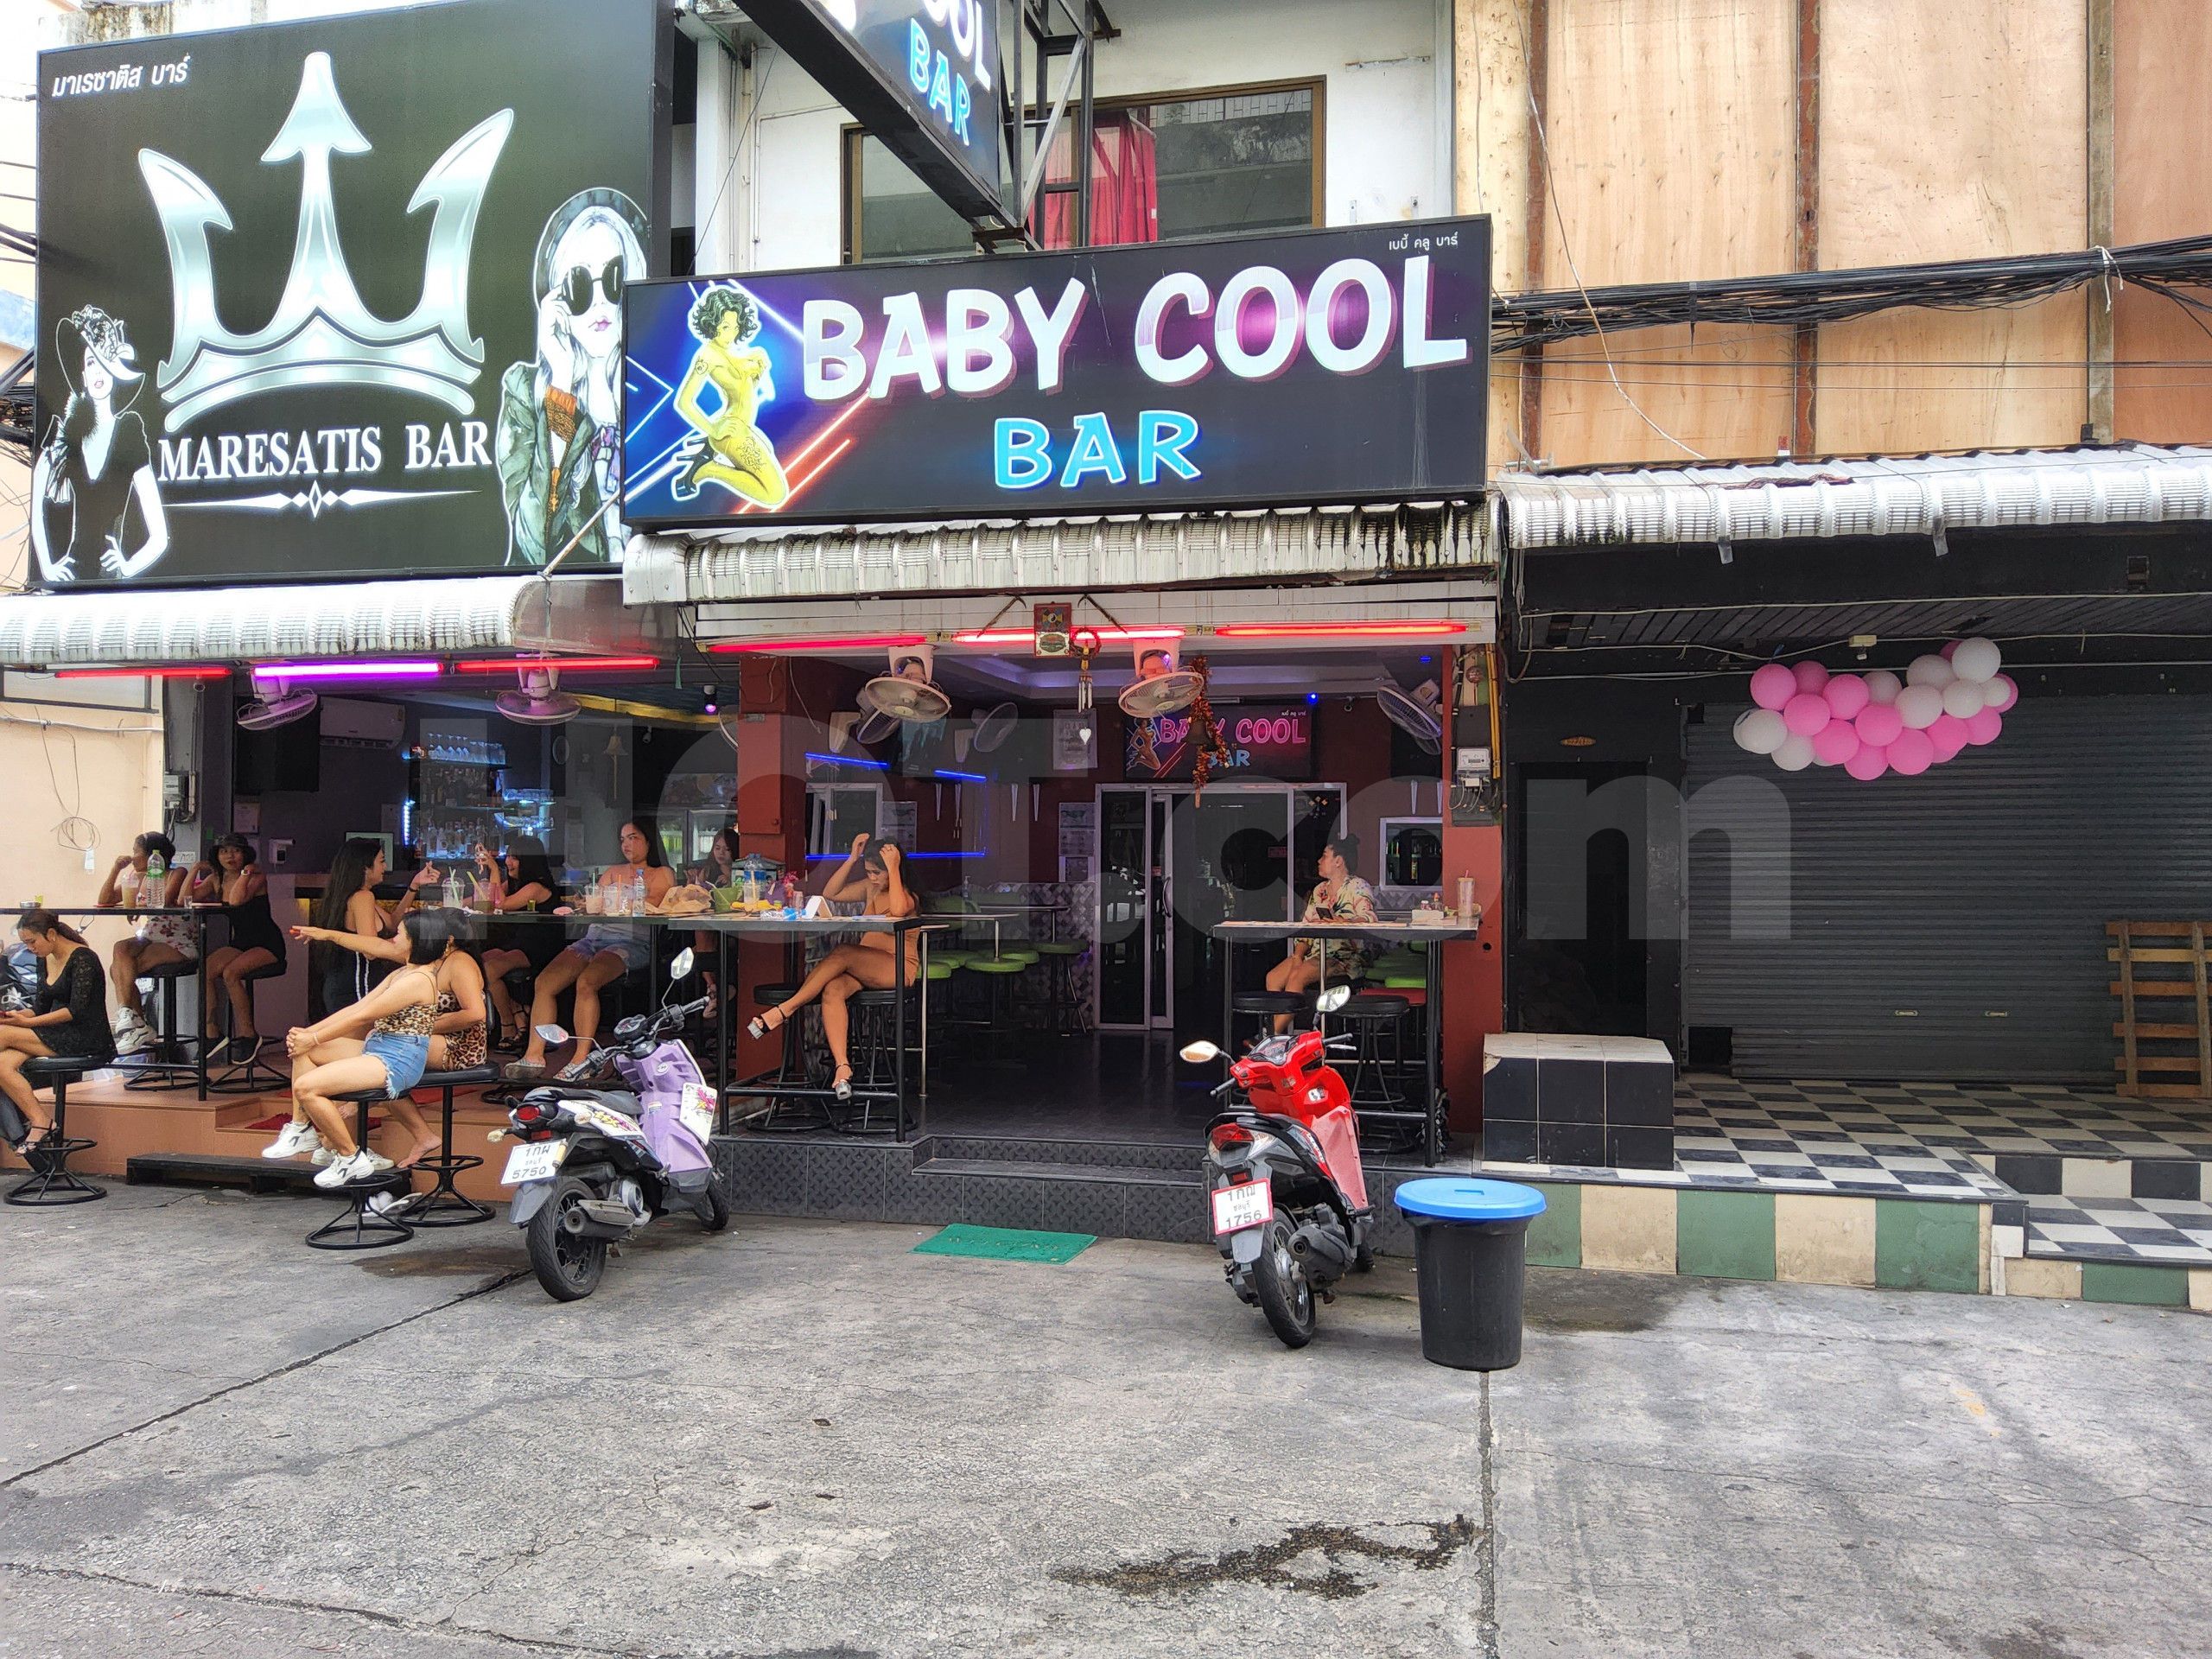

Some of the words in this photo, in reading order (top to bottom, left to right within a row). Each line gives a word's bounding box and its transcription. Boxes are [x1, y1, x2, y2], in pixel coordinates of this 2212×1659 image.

[52, 64, 143, 98] มาเรซาติส
[151, 52, 191, 86] บาร์
[924, 0, 991, 92] OL
[910, 17, 971, 146] BAR
[802, 278, 1086, 401] BABY
[1135, 256, 1468, 385] COOL
[157, 426, 382, 481] MARESATIS
[404, 421, 493, 469] BAR
[994, 410, 1203, 491] BAR
[1160, 717, 1226, 743] BA
[1236, 717, 1306, 744] COOL
[512, 1166, 547, 1179] 5750
[1225, 1210, 1262, 1228] 1756
